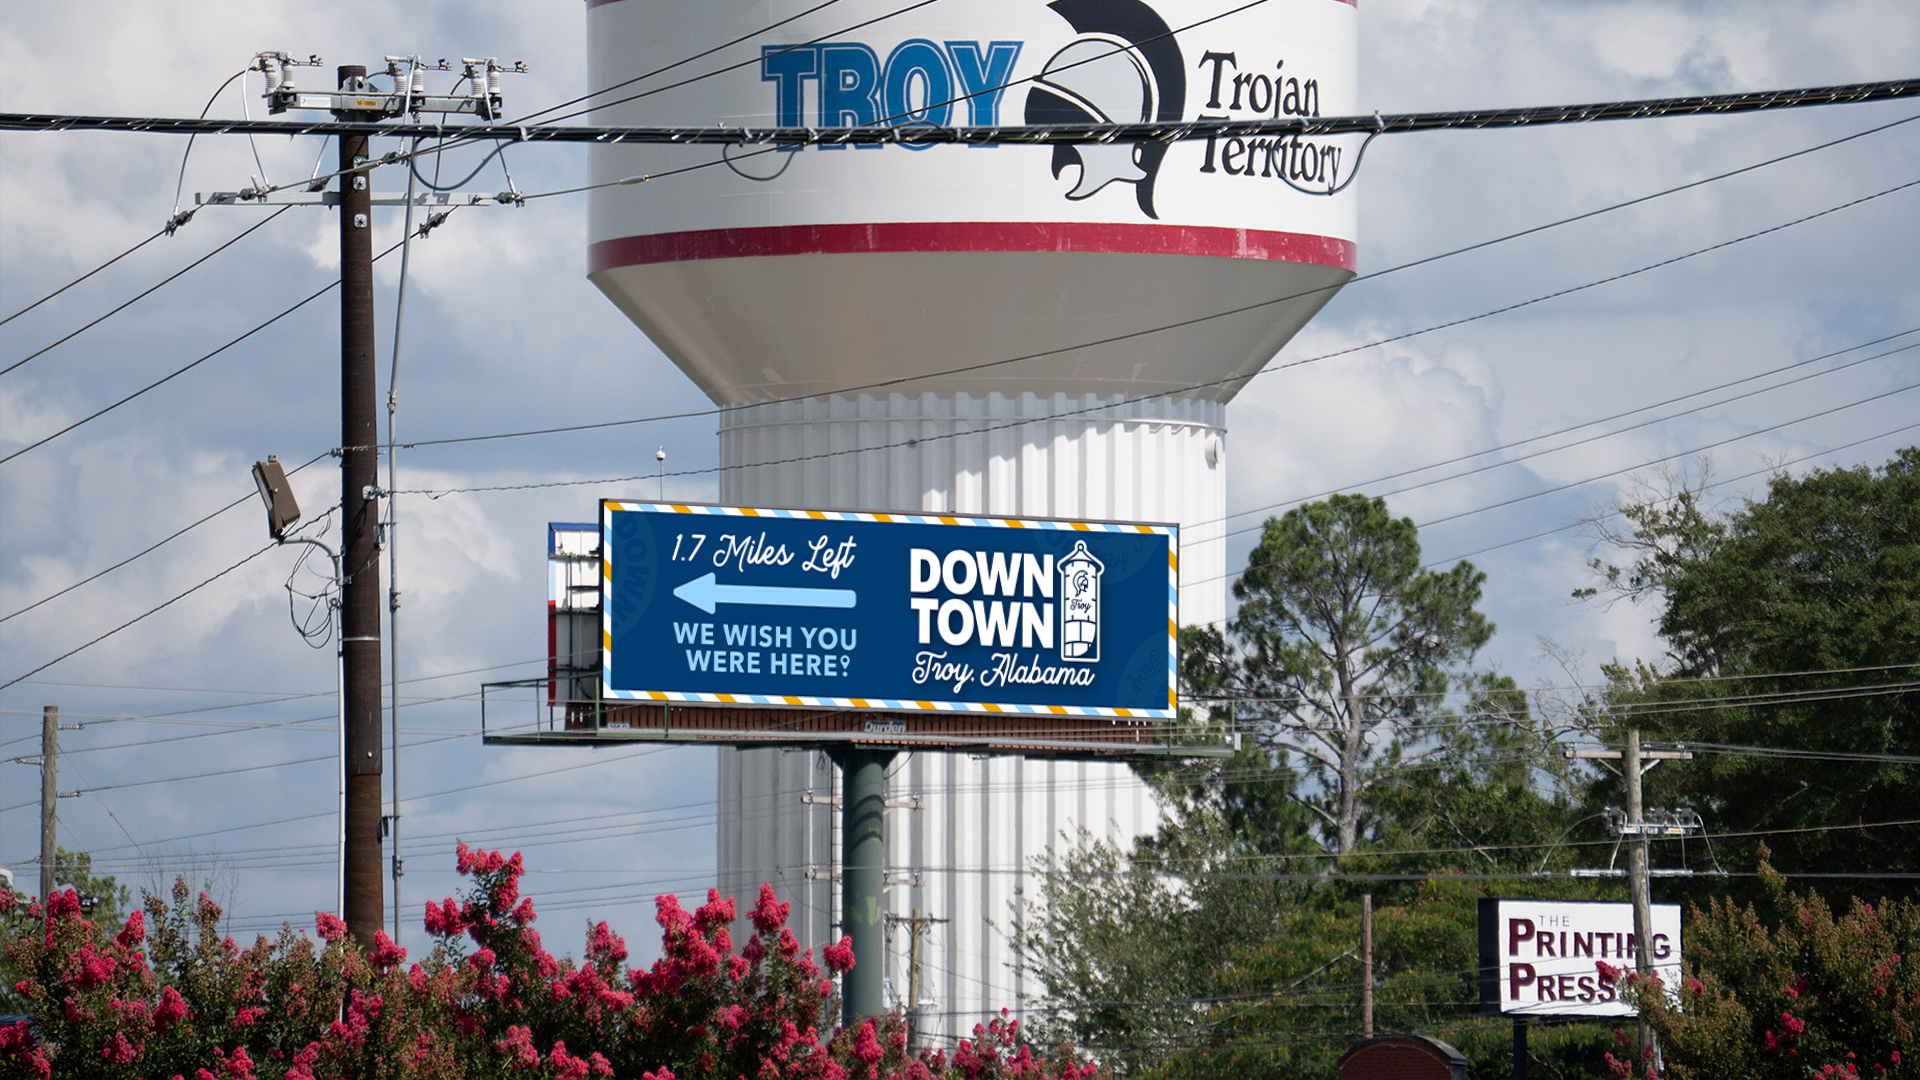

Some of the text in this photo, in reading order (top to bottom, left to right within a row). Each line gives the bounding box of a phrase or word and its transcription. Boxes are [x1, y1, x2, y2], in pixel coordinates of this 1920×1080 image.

[761, 38, 1024, 152] TROY
[1198, 49, 1321, 119] Trojan
[1196, 113, 1342, 196] Territory
[672, 531, 857, 580] 1.7 Miles Left
[909, 548, 1054, 598] DOWN
[910, 597, 1054, 649] TOWN
[1069, 598, 1092, 614] Troy
[673, 621, 858, 651] WE WISH YOU
[685, 649, 761, 674] WERE
[980, 652, 1095, 687] Alabama
[863, 720, 907, 734] Durden
[1538, 915, 1570, 927] THE
[1509, 962, 1616, 1003] PRESS
